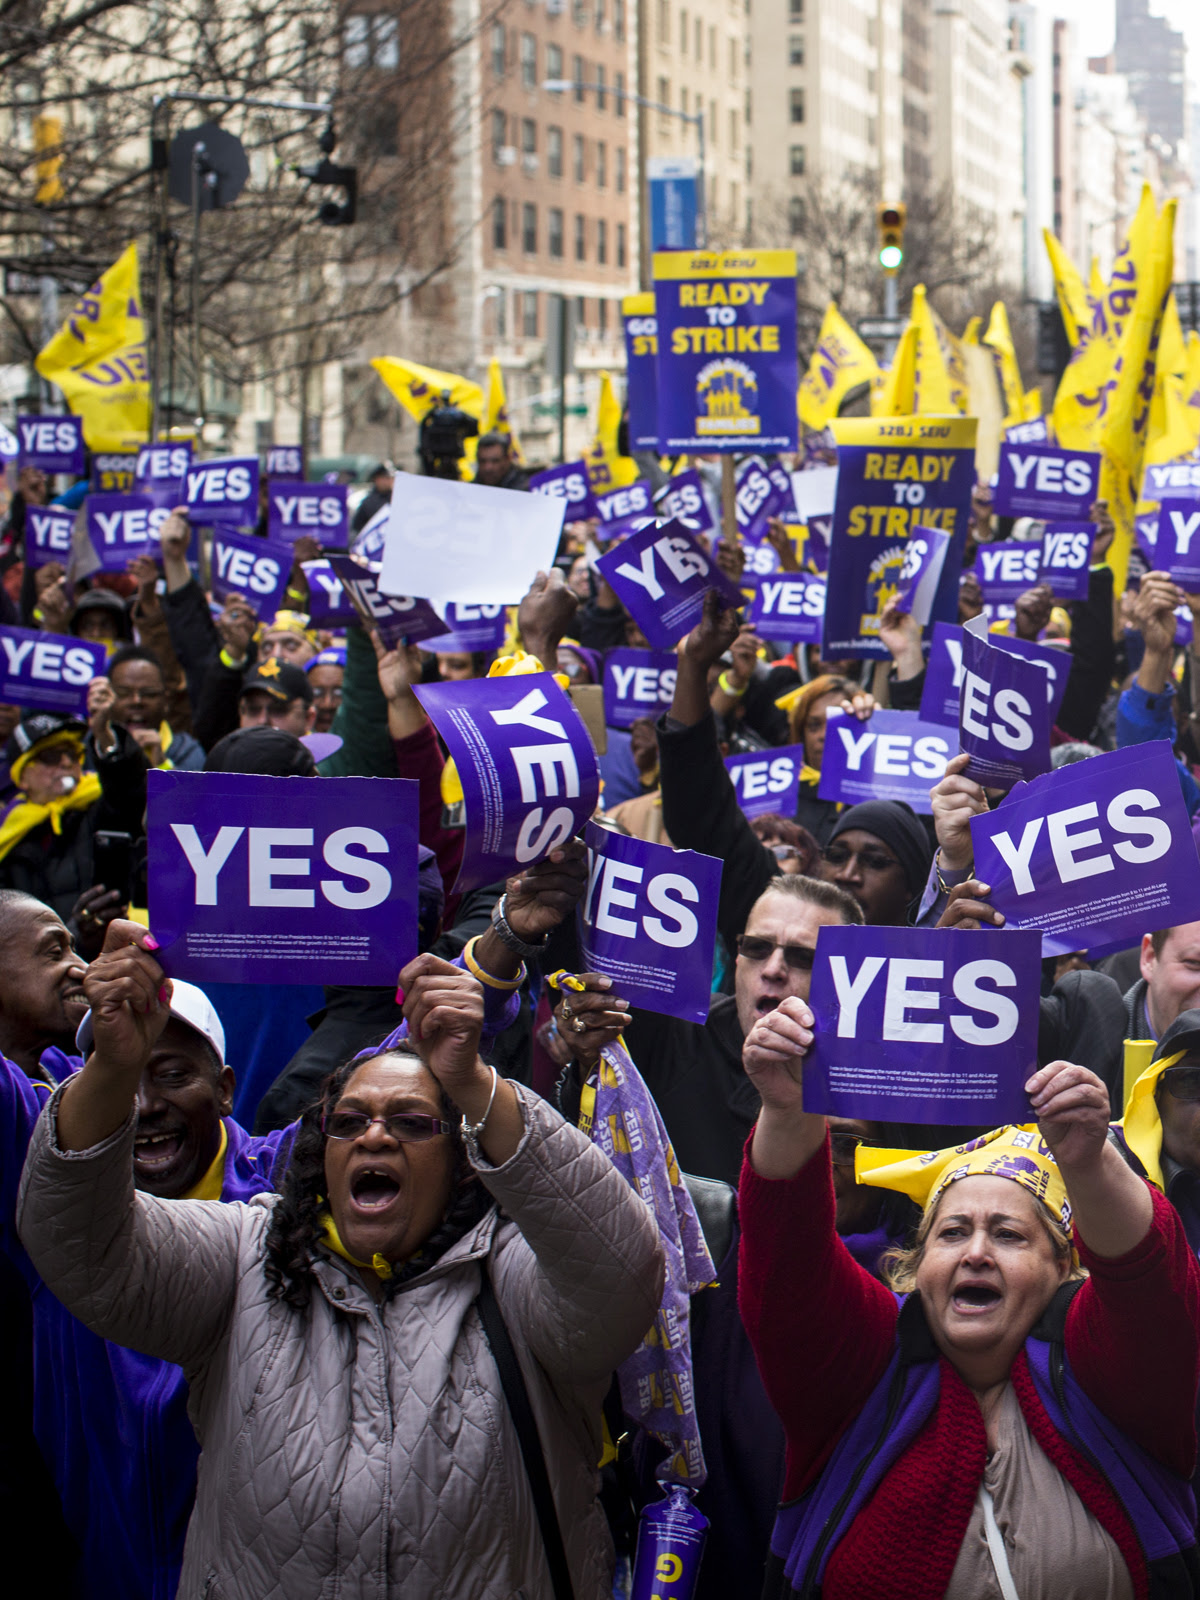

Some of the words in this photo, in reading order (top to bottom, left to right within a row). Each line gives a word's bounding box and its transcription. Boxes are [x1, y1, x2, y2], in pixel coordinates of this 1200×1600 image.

[680, 282, 770, 307] READY
[705, 306, 737, 325] TO
[671, 325, 780, 355] STRIKE
[22, 423, 77, 452] YES
[1007, 421, 1048, 445] YES
[266, 449, 300, 474] YES
[864, 453, 956, 482] READY
[1007, 453, 1092, 495] YES
[186, 466, 252, 502] YES
[893, 483, 926, 505] TO
[275, 496, 344, 528] YES
[597, 486, 649, 521] YES
[30, 514, 76, 552] YE
[846, 505, 958, 538] STRIKE
[1043, 532, 1089, 569] YES
[214, 541, 281, 615] YES
[761, 582, 827, 616] YES
[0, 637, 95, 685] YES
[611, 664, 678, 703] YES
[837, 727, 949, 779] YES
[488, 688, 581, 864] YES
[989, 788, 1172, 896] YES
[169, 823, 392, 910] YES
[828, 955, 1019, 1046] YES
